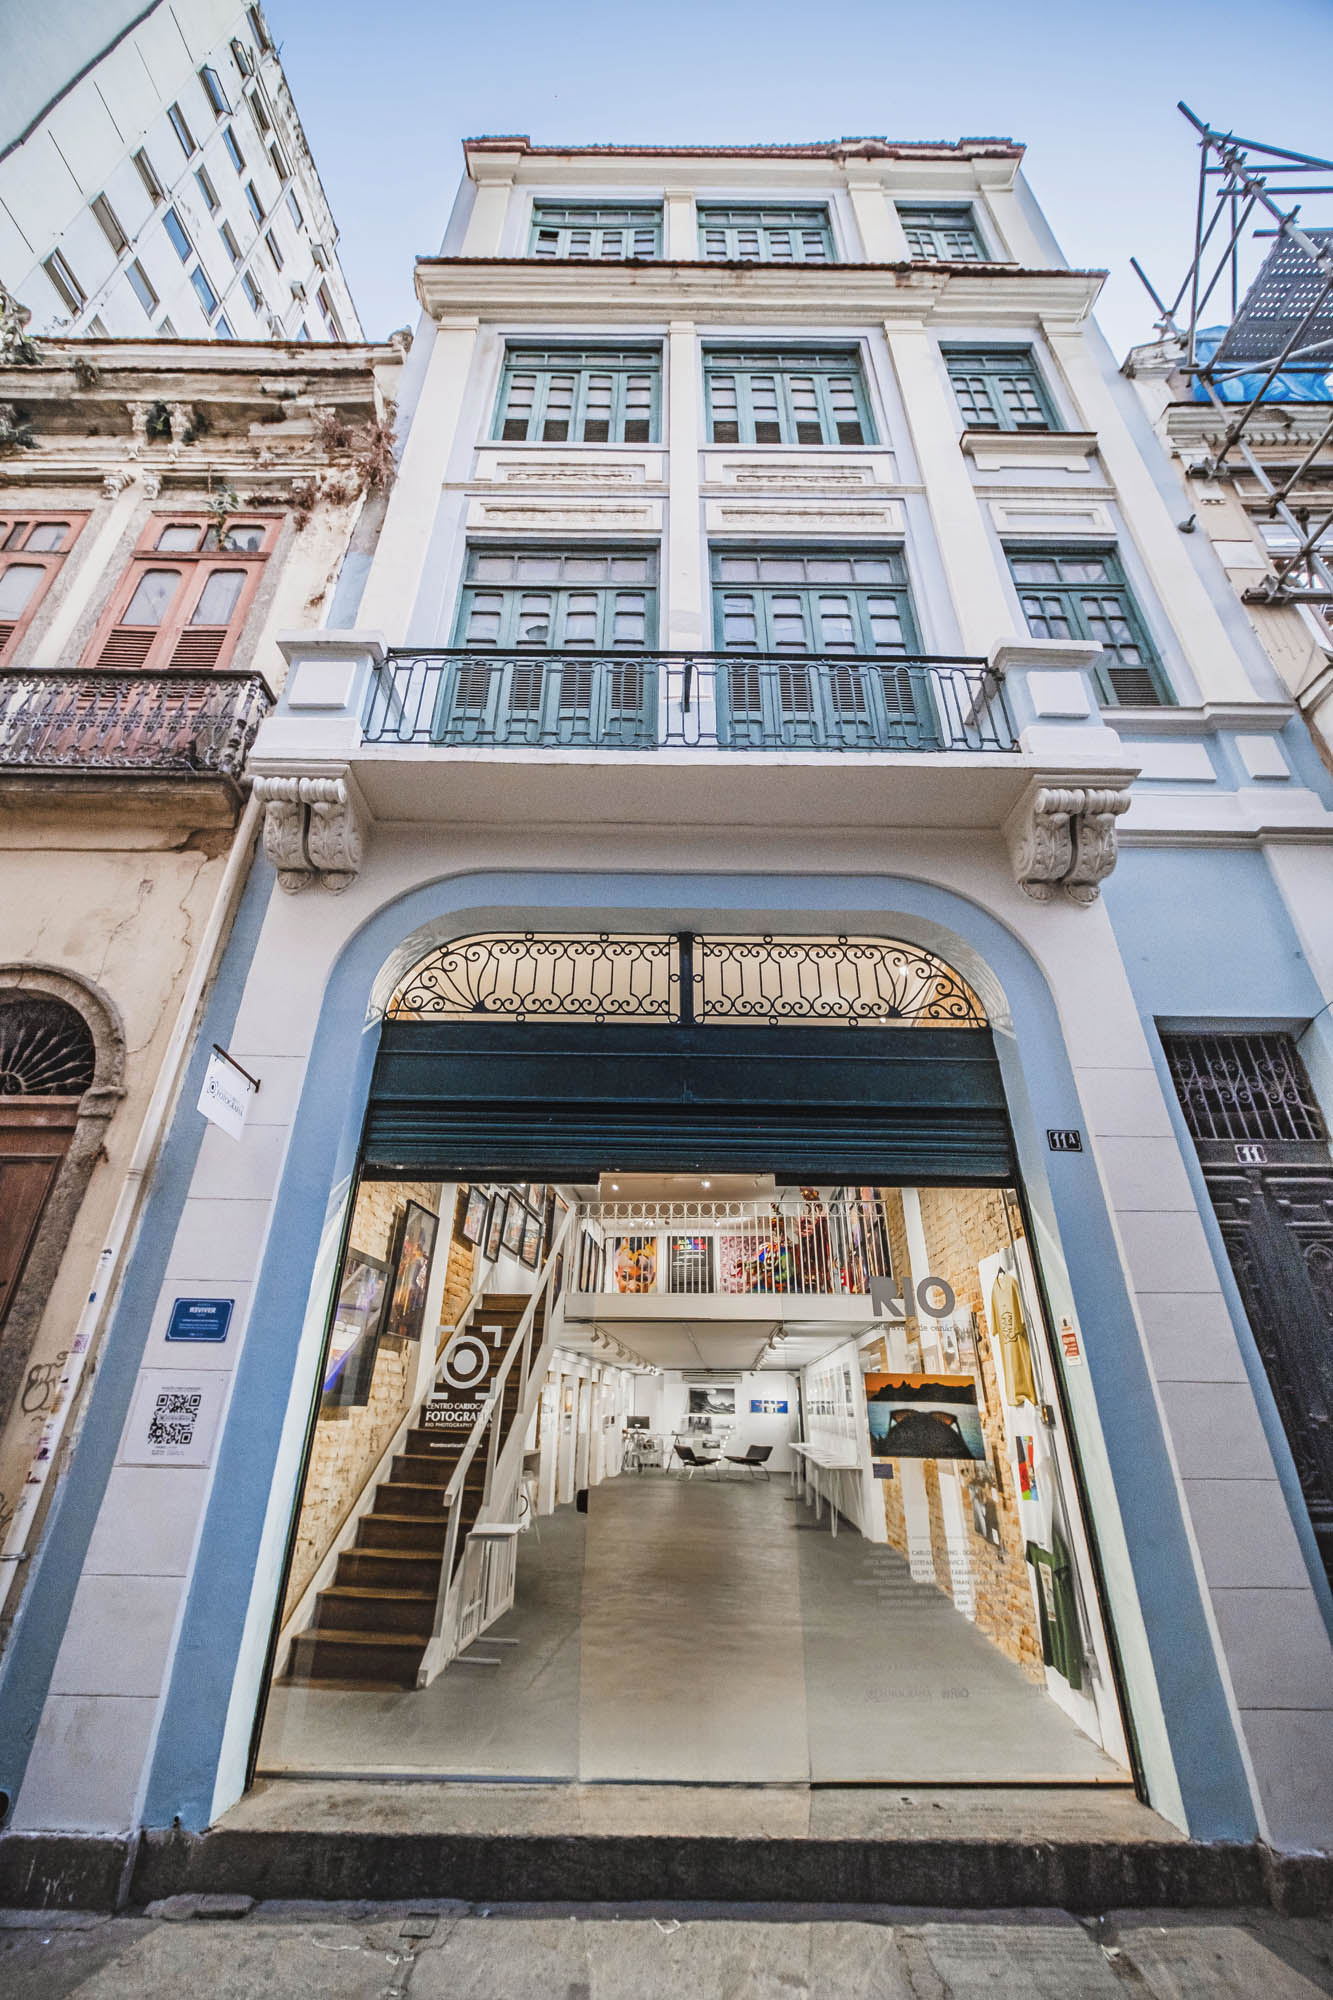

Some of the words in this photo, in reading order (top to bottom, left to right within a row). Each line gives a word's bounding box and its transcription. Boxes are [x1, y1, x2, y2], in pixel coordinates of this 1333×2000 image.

[1052, 1132, 1075, 1148] 11A
[1242, 1146, 1261, 1163] 11
[869, 1276, 955, 1319] RIO
[426, 1402, 454, 1410] CENTRO
[454, 1402, 484, 1410] CARIOCA
